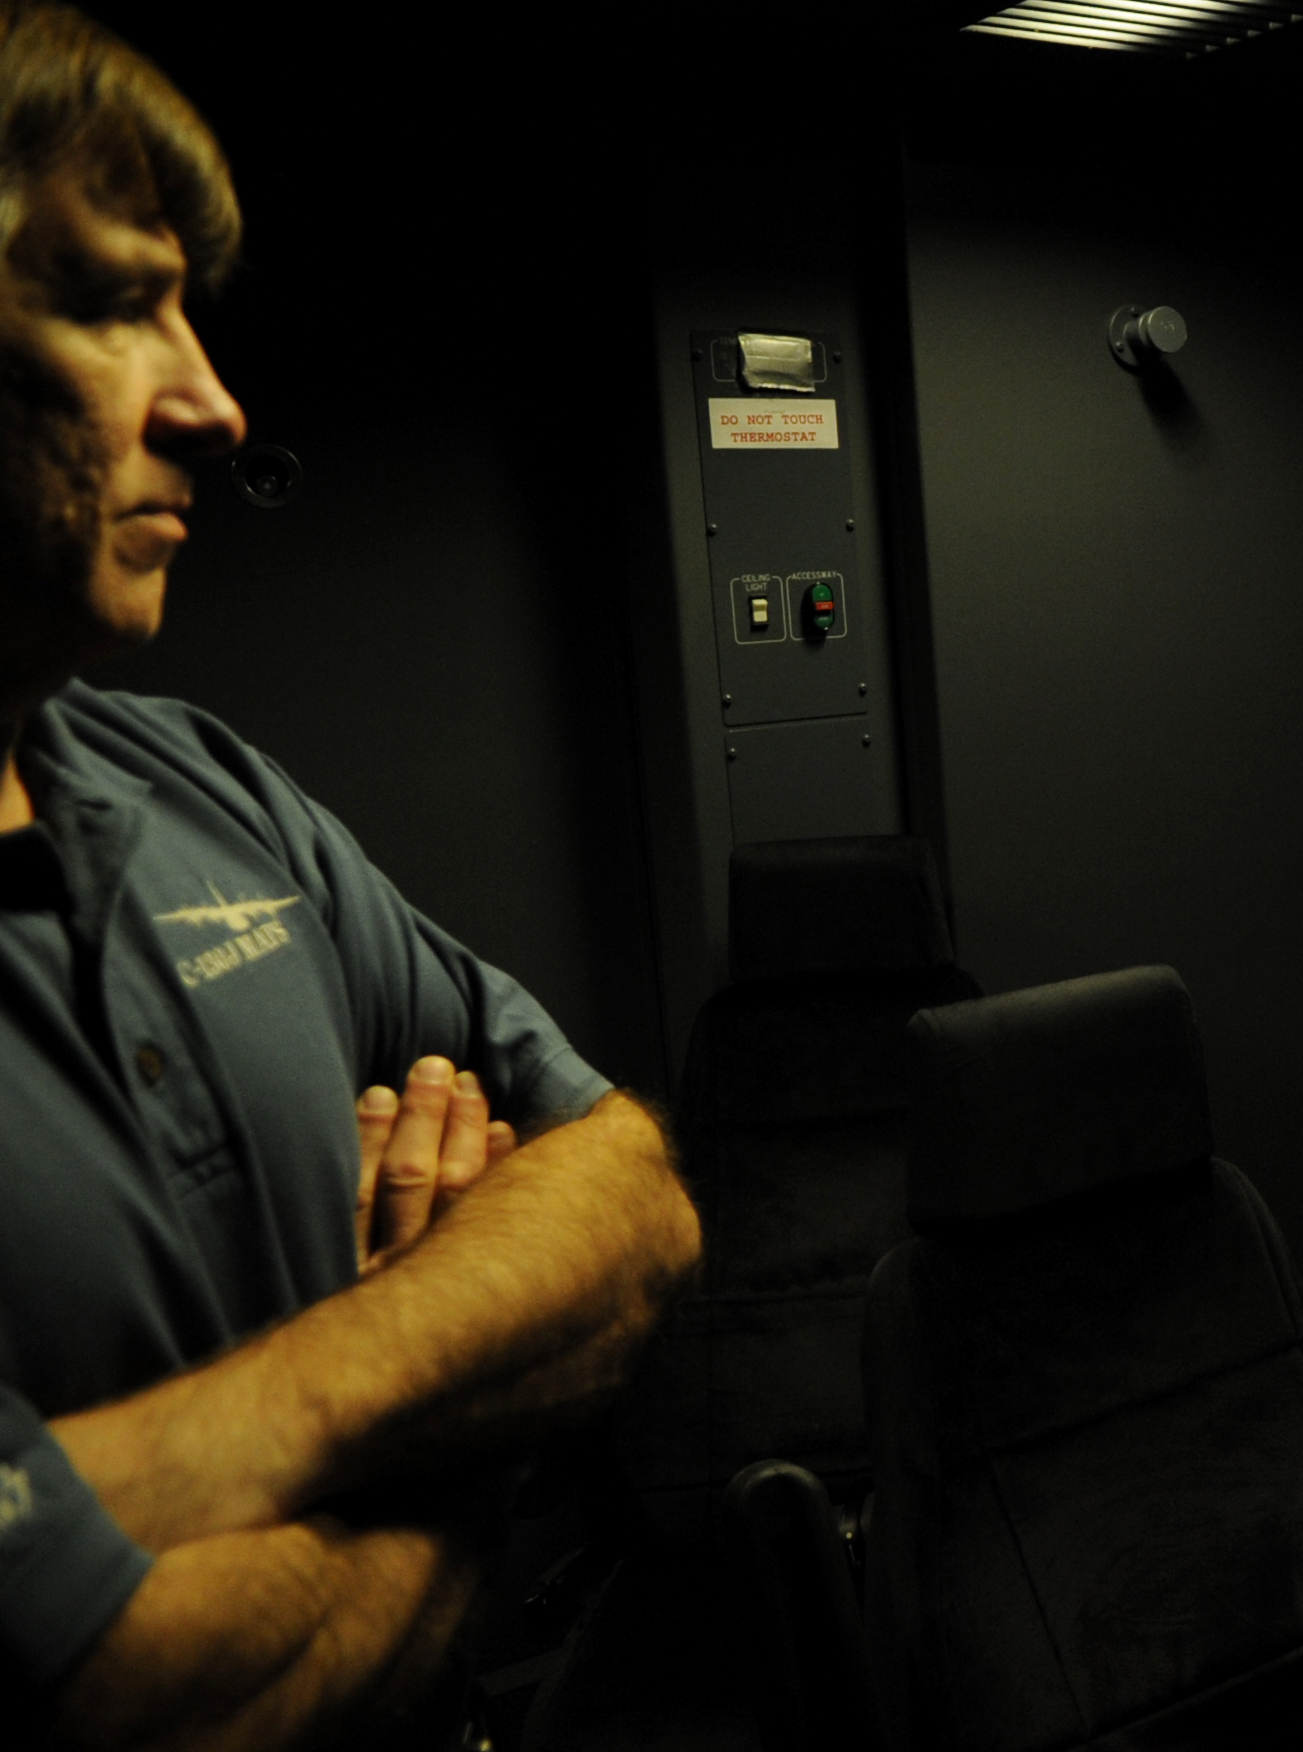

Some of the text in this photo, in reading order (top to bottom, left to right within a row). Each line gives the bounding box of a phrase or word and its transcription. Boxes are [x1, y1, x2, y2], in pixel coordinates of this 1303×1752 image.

[721, 415, 824, 425] DO NOT TOUCH
[731, 432, 816, 442] THERMOSTAT
[742, 574, 771, 583] CEILING
[792, 570, 837, 579] ACCESSWAY
[746, 583, 767, 591] LIGHT
